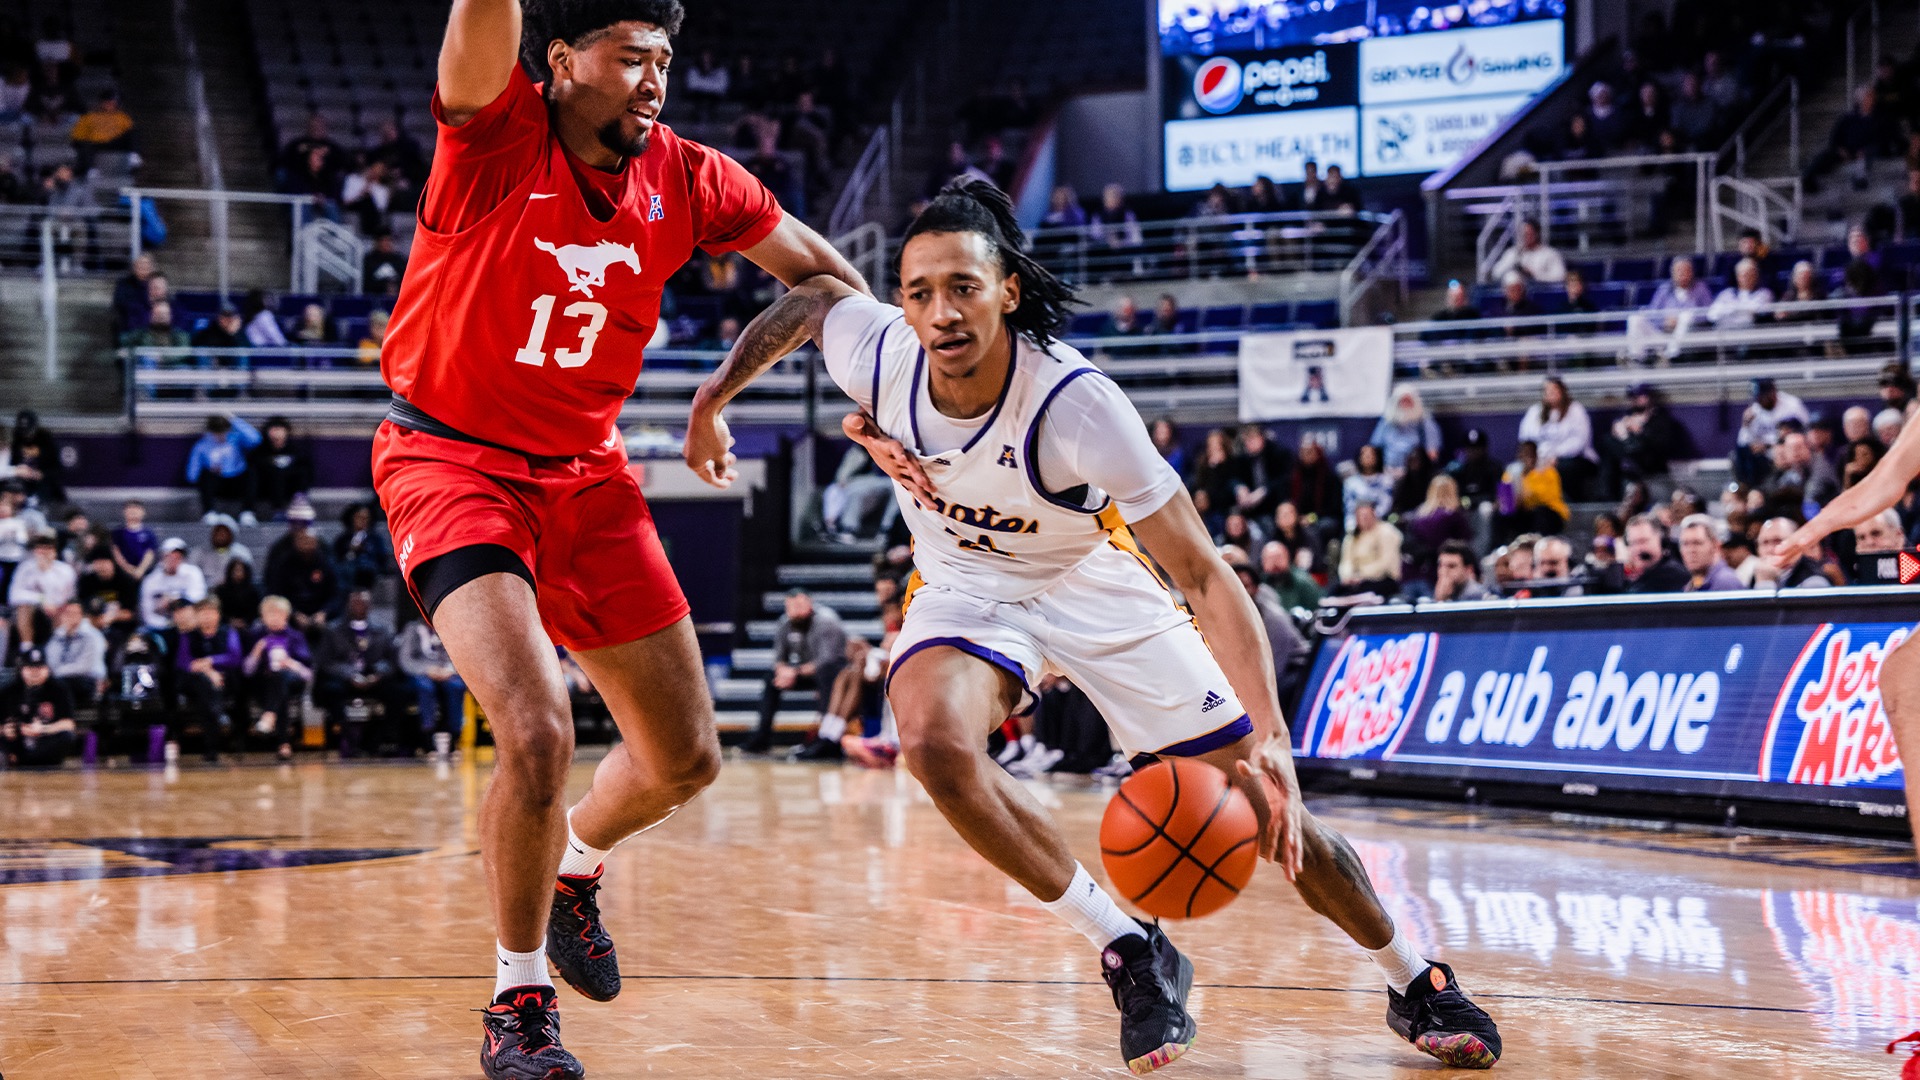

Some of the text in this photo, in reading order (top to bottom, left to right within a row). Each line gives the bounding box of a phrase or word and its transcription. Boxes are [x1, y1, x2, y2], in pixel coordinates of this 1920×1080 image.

[1243, 50, 1326, 95] pepsi
[1253, 132, 1351, 158] HEALTH
[514, 294, 609, 369] 13
[1201, 697, 1227, 713] adidas
[1425, 645, 1720, 755] a sub above
[1796, 627, 1909, 724] Jer
[1787, 695, 1904, 787] Mike
